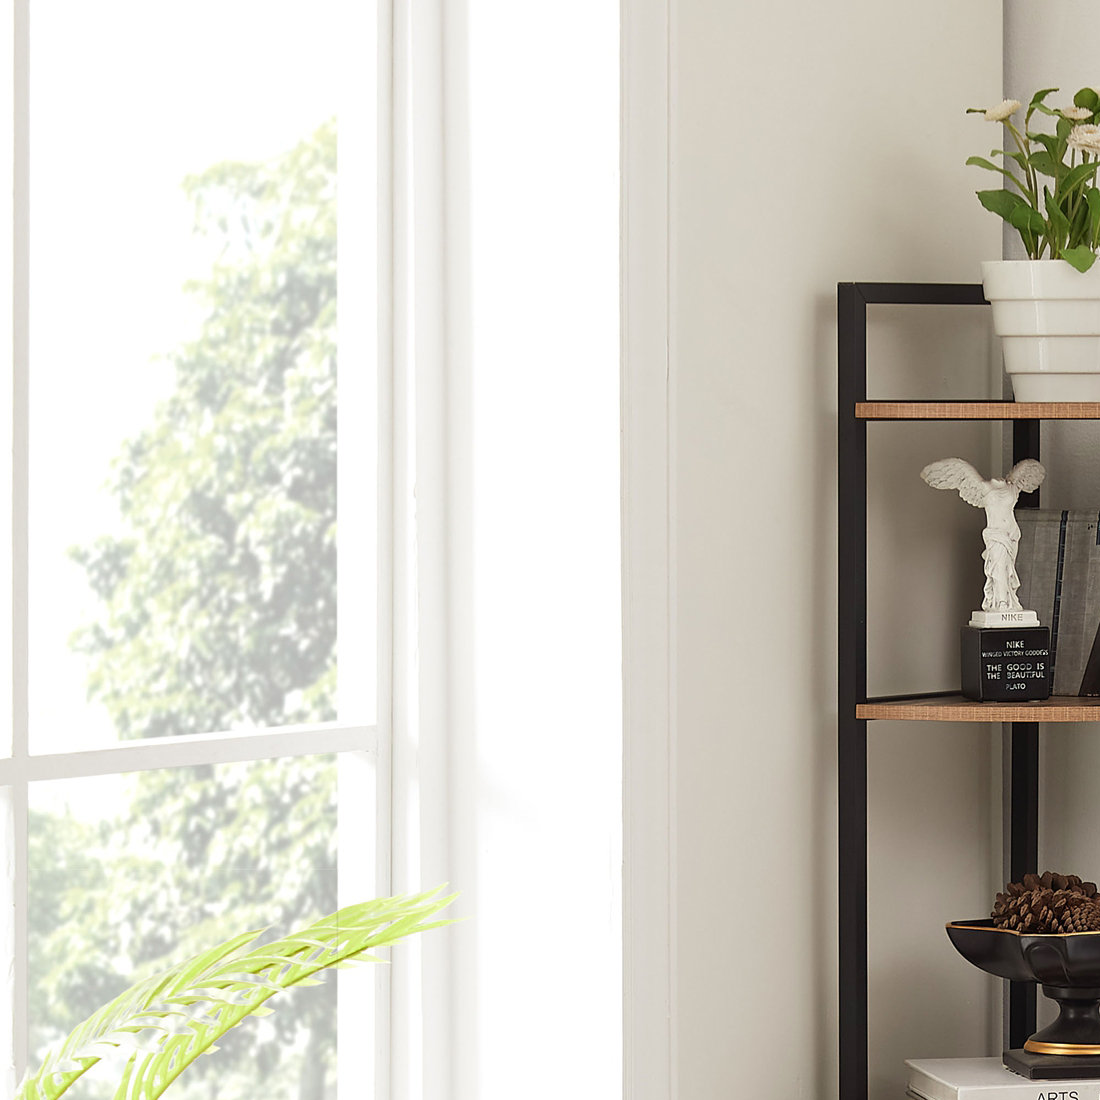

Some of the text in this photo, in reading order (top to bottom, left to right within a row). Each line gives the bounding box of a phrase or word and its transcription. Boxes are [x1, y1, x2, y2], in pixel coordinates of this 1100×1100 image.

[1002, 613, 1023, 621] NIKE
[1006, 640, 1024, 648] NIKE
[986, 662, 1045, 672] THE GOOD IS
[986, 671, 1045, 680] THE BEAUTIFUL
